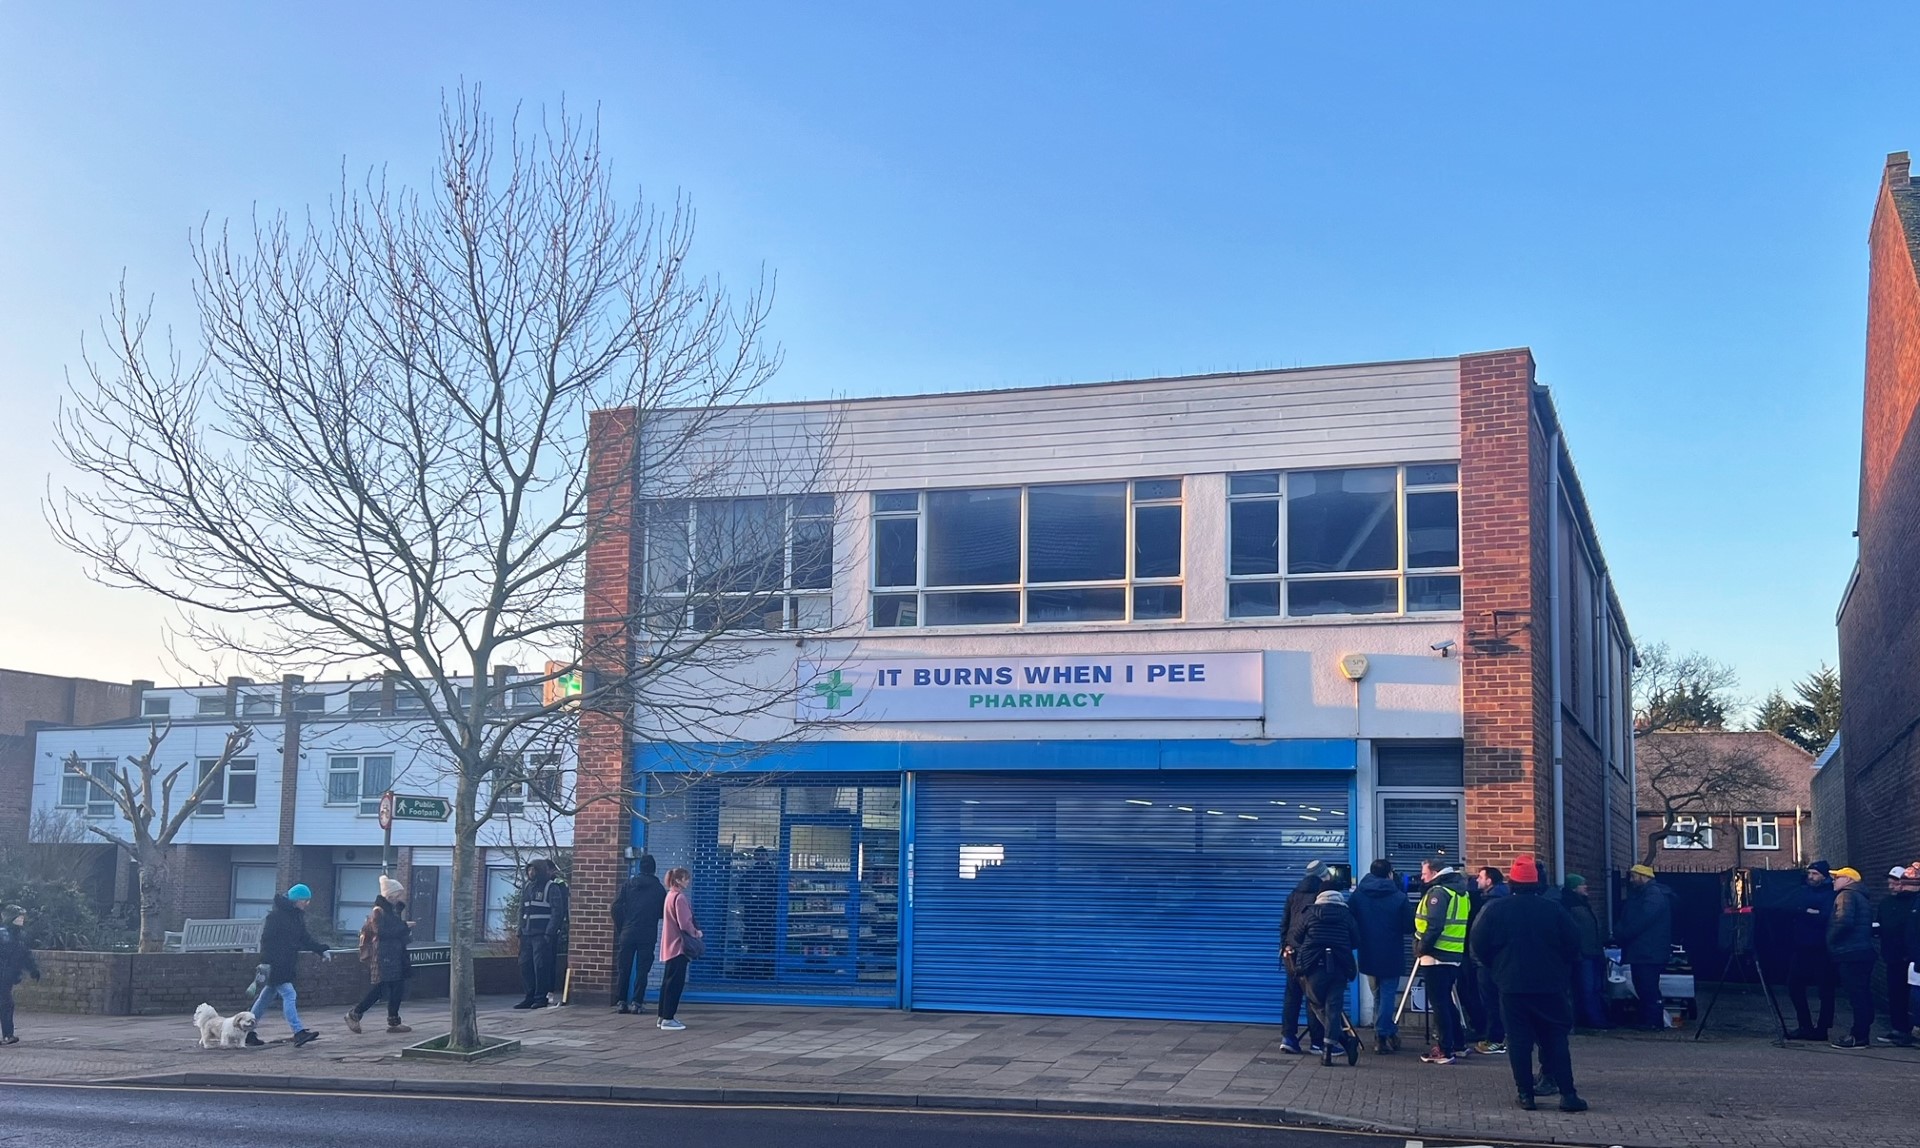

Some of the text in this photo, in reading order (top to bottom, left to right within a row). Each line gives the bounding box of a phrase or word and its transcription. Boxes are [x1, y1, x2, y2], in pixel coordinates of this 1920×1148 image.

[878, 664, 1206, 686] IT BURNS WHEN I PEE
[969, 693, 1105, 708] PHARMACY
[414, 800, 436, 809] Public
[408, 807, 441, 817] Footpath
